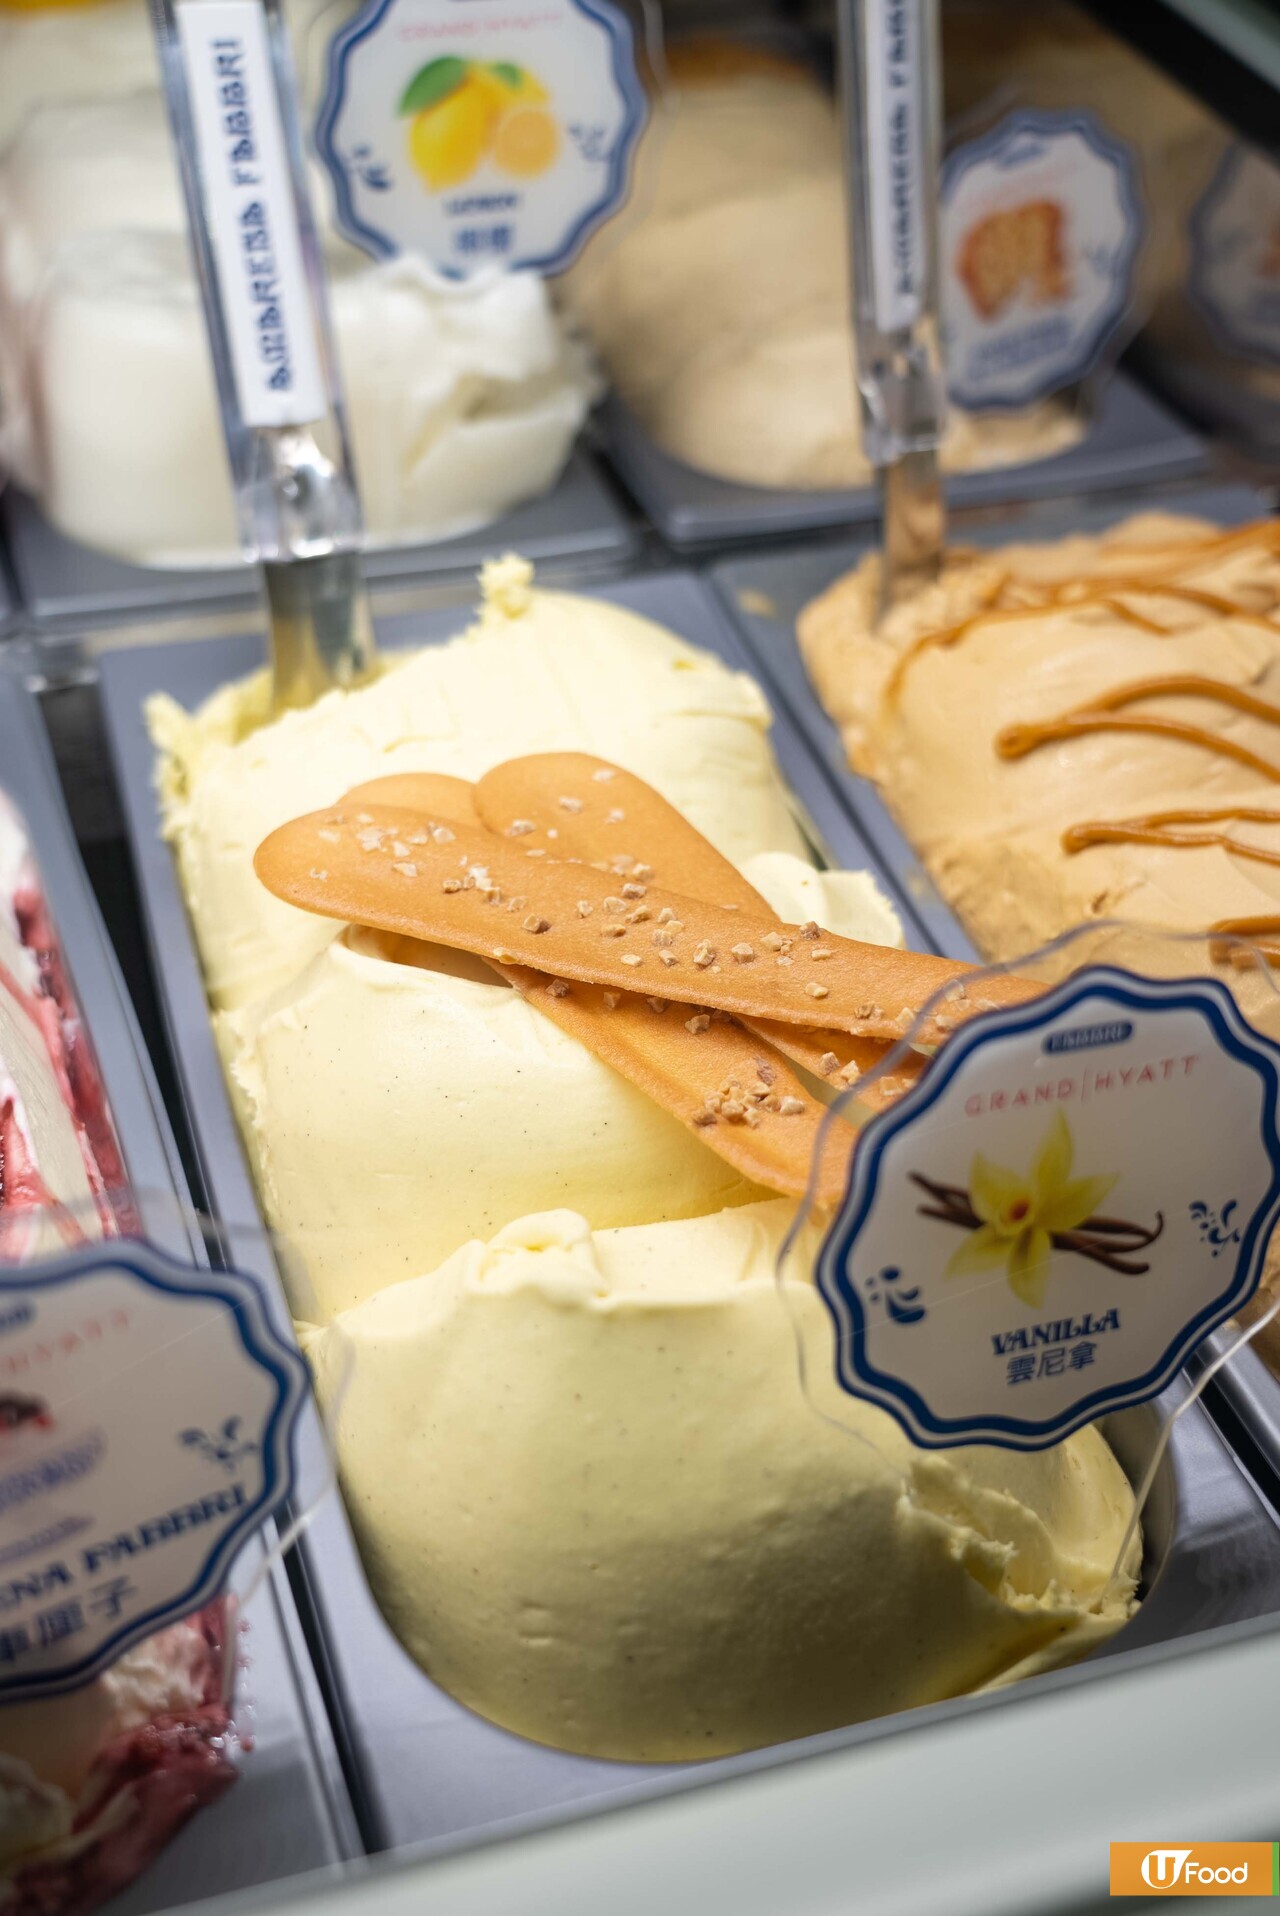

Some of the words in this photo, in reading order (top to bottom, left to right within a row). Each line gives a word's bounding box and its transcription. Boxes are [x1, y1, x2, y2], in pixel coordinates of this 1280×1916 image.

[963, 1079, 1073, 1117] GRAND
[1093, 1055, 1200, 1092] HYATT
[991, 1308, 1121, 1356] VANILLA
[1006, 1340, 1098, 1386] 雲尼拿
